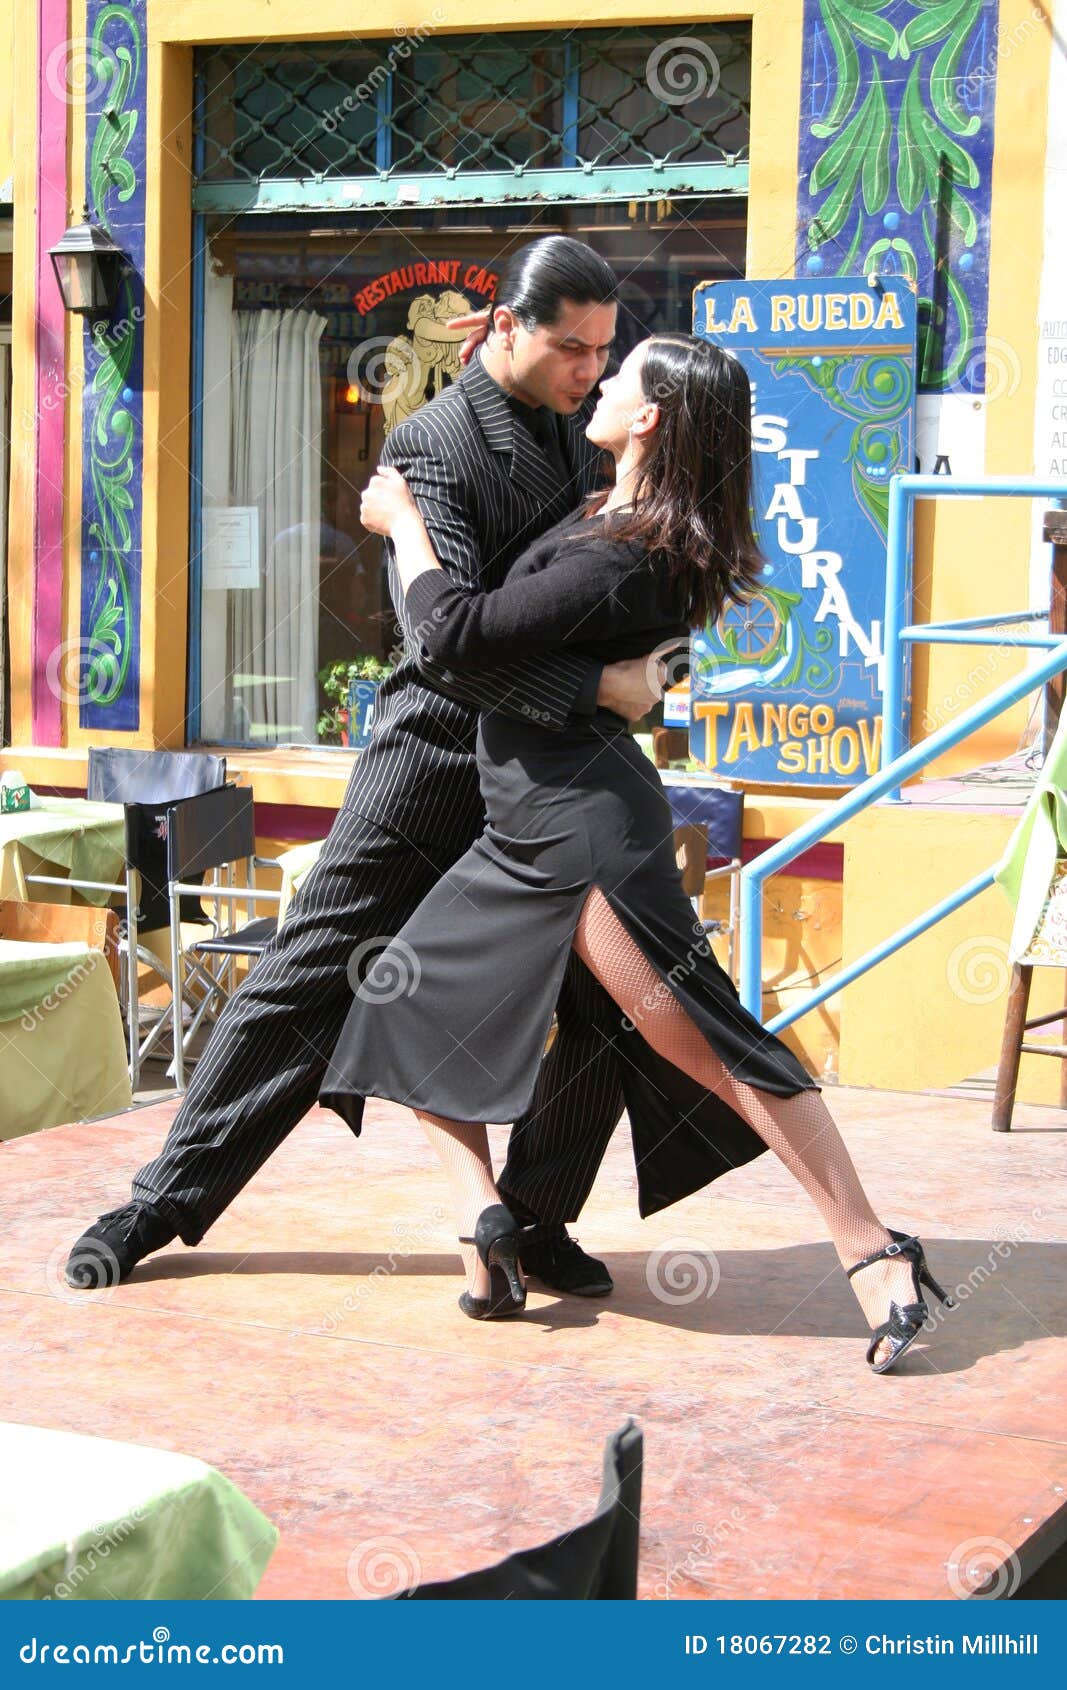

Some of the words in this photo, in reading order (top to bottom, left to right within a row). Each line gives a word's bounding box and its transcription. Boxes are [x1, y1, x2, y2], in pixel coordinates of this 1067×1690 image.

[354, 260, 462, 317] RESTAURANT
[704, 297, 759, 333] LA
[770, 292, 905, 332] RUEDA
[725, 349, 885, 692] STAURAN
[693, 701, 835, 770] TANGO
